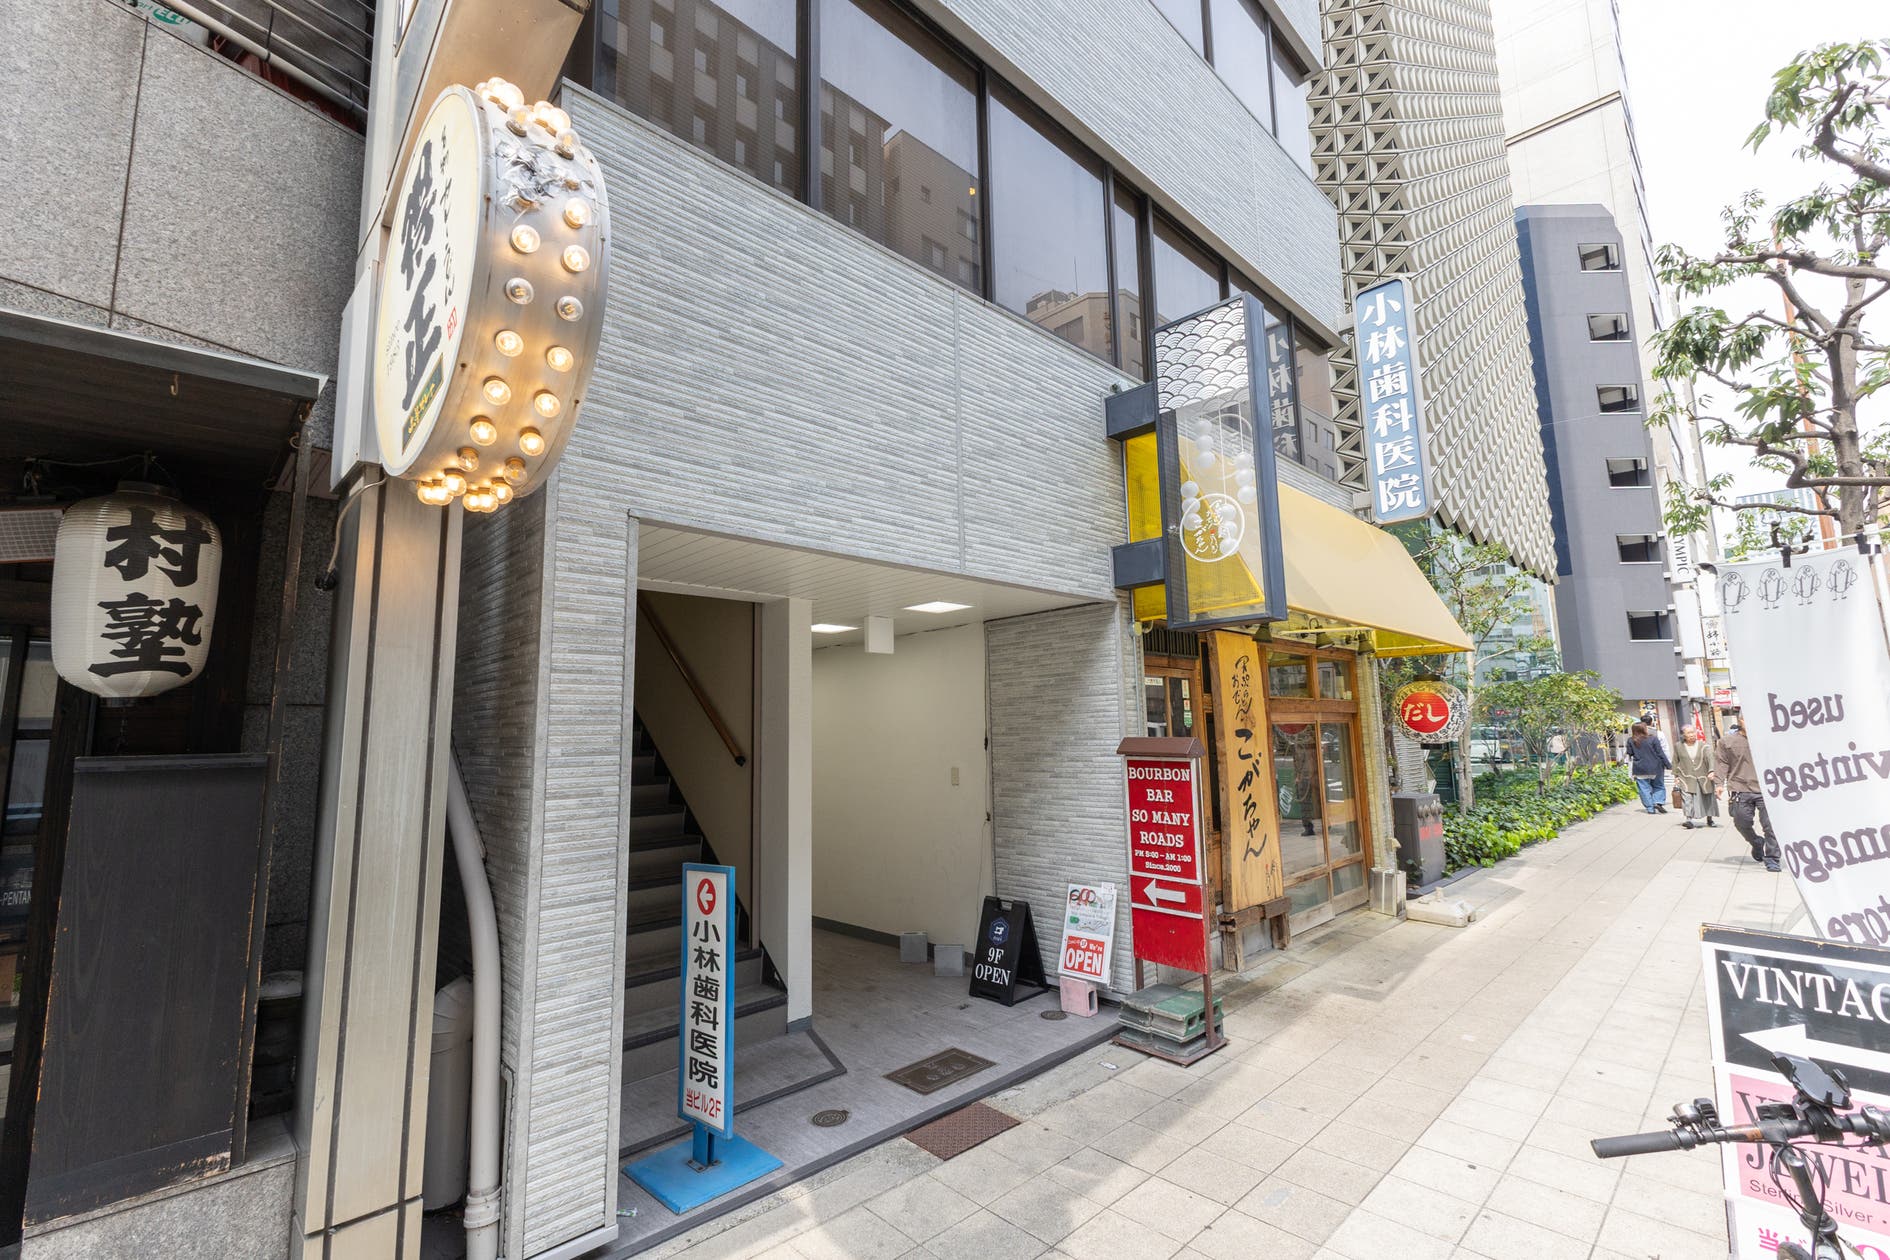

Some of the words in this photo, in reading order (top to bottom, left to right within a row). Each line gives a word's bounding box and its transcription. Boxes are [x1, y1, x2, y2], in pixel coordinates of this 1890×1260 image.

[1361, 291, 1421, 514] 小林歯科医院
[88, 506, 212, 677] 村塾
[1403, 702, 1447, 723] だし
[1128, 767, 1191, 782] BOURBON
[1146, 789, 1174, 803] BAR
[1234, 728, 1268, 862] こがちゃん
[1132, 809, 1148, 823] SO
[1152, 811, 1190, 827] MANY
[1140, 831, 1184, 847] ROADS
[1134, 849, 1144, 857] PM
[1165, 853, 1176, 861] AM
[987, 947, 1004, 964] 9F
[1065, 947, 1103, 974] OPEN
[975, 963, 1012, 986] OPEN
[689, 920, 721, 1089] 小林歯科医院
[686, 1088, 721, 1118] 当ビル2F
[1823, 1200, 1874, 1223] Silver
